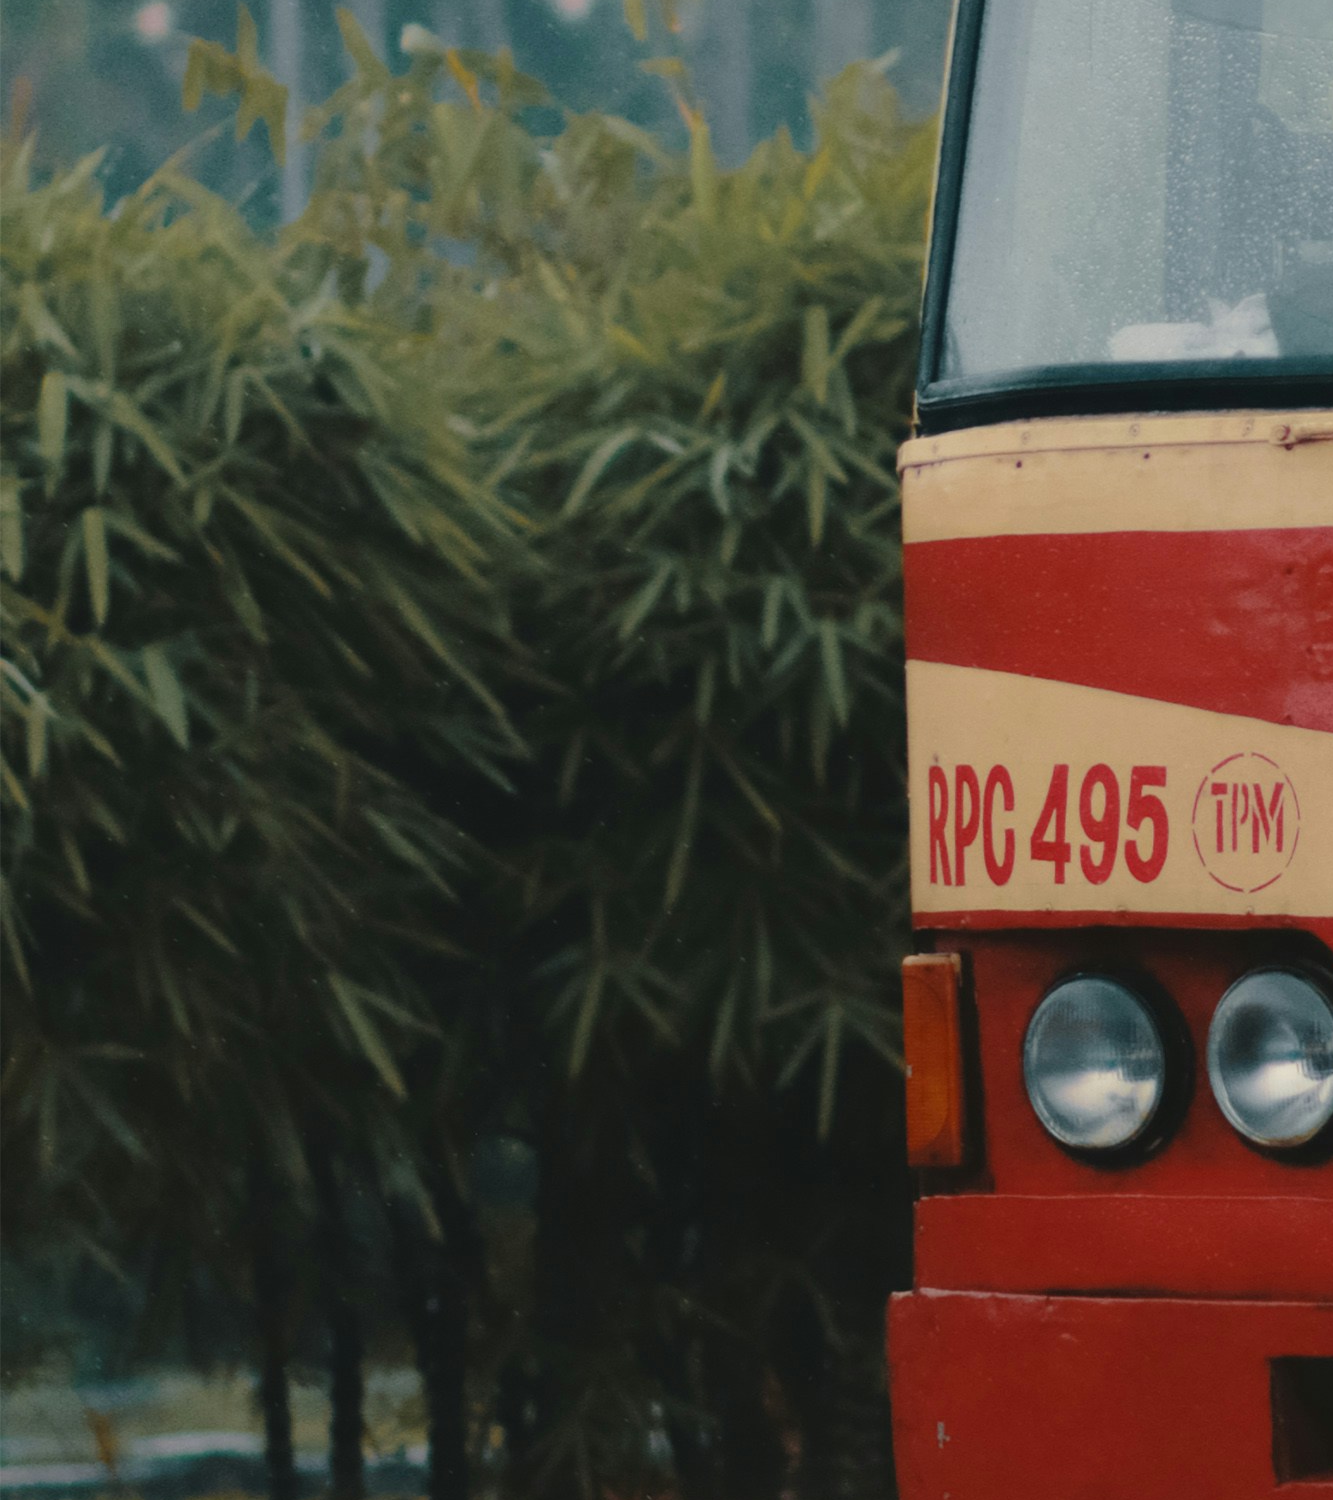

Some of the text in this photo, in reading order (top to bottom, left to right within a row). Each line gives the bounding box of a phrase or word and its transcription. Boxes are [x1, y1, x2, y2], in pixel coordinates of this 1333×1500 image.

[929, 763, 1169, 886] RPC 495
[1211, 782, 1284, 853] TPM
